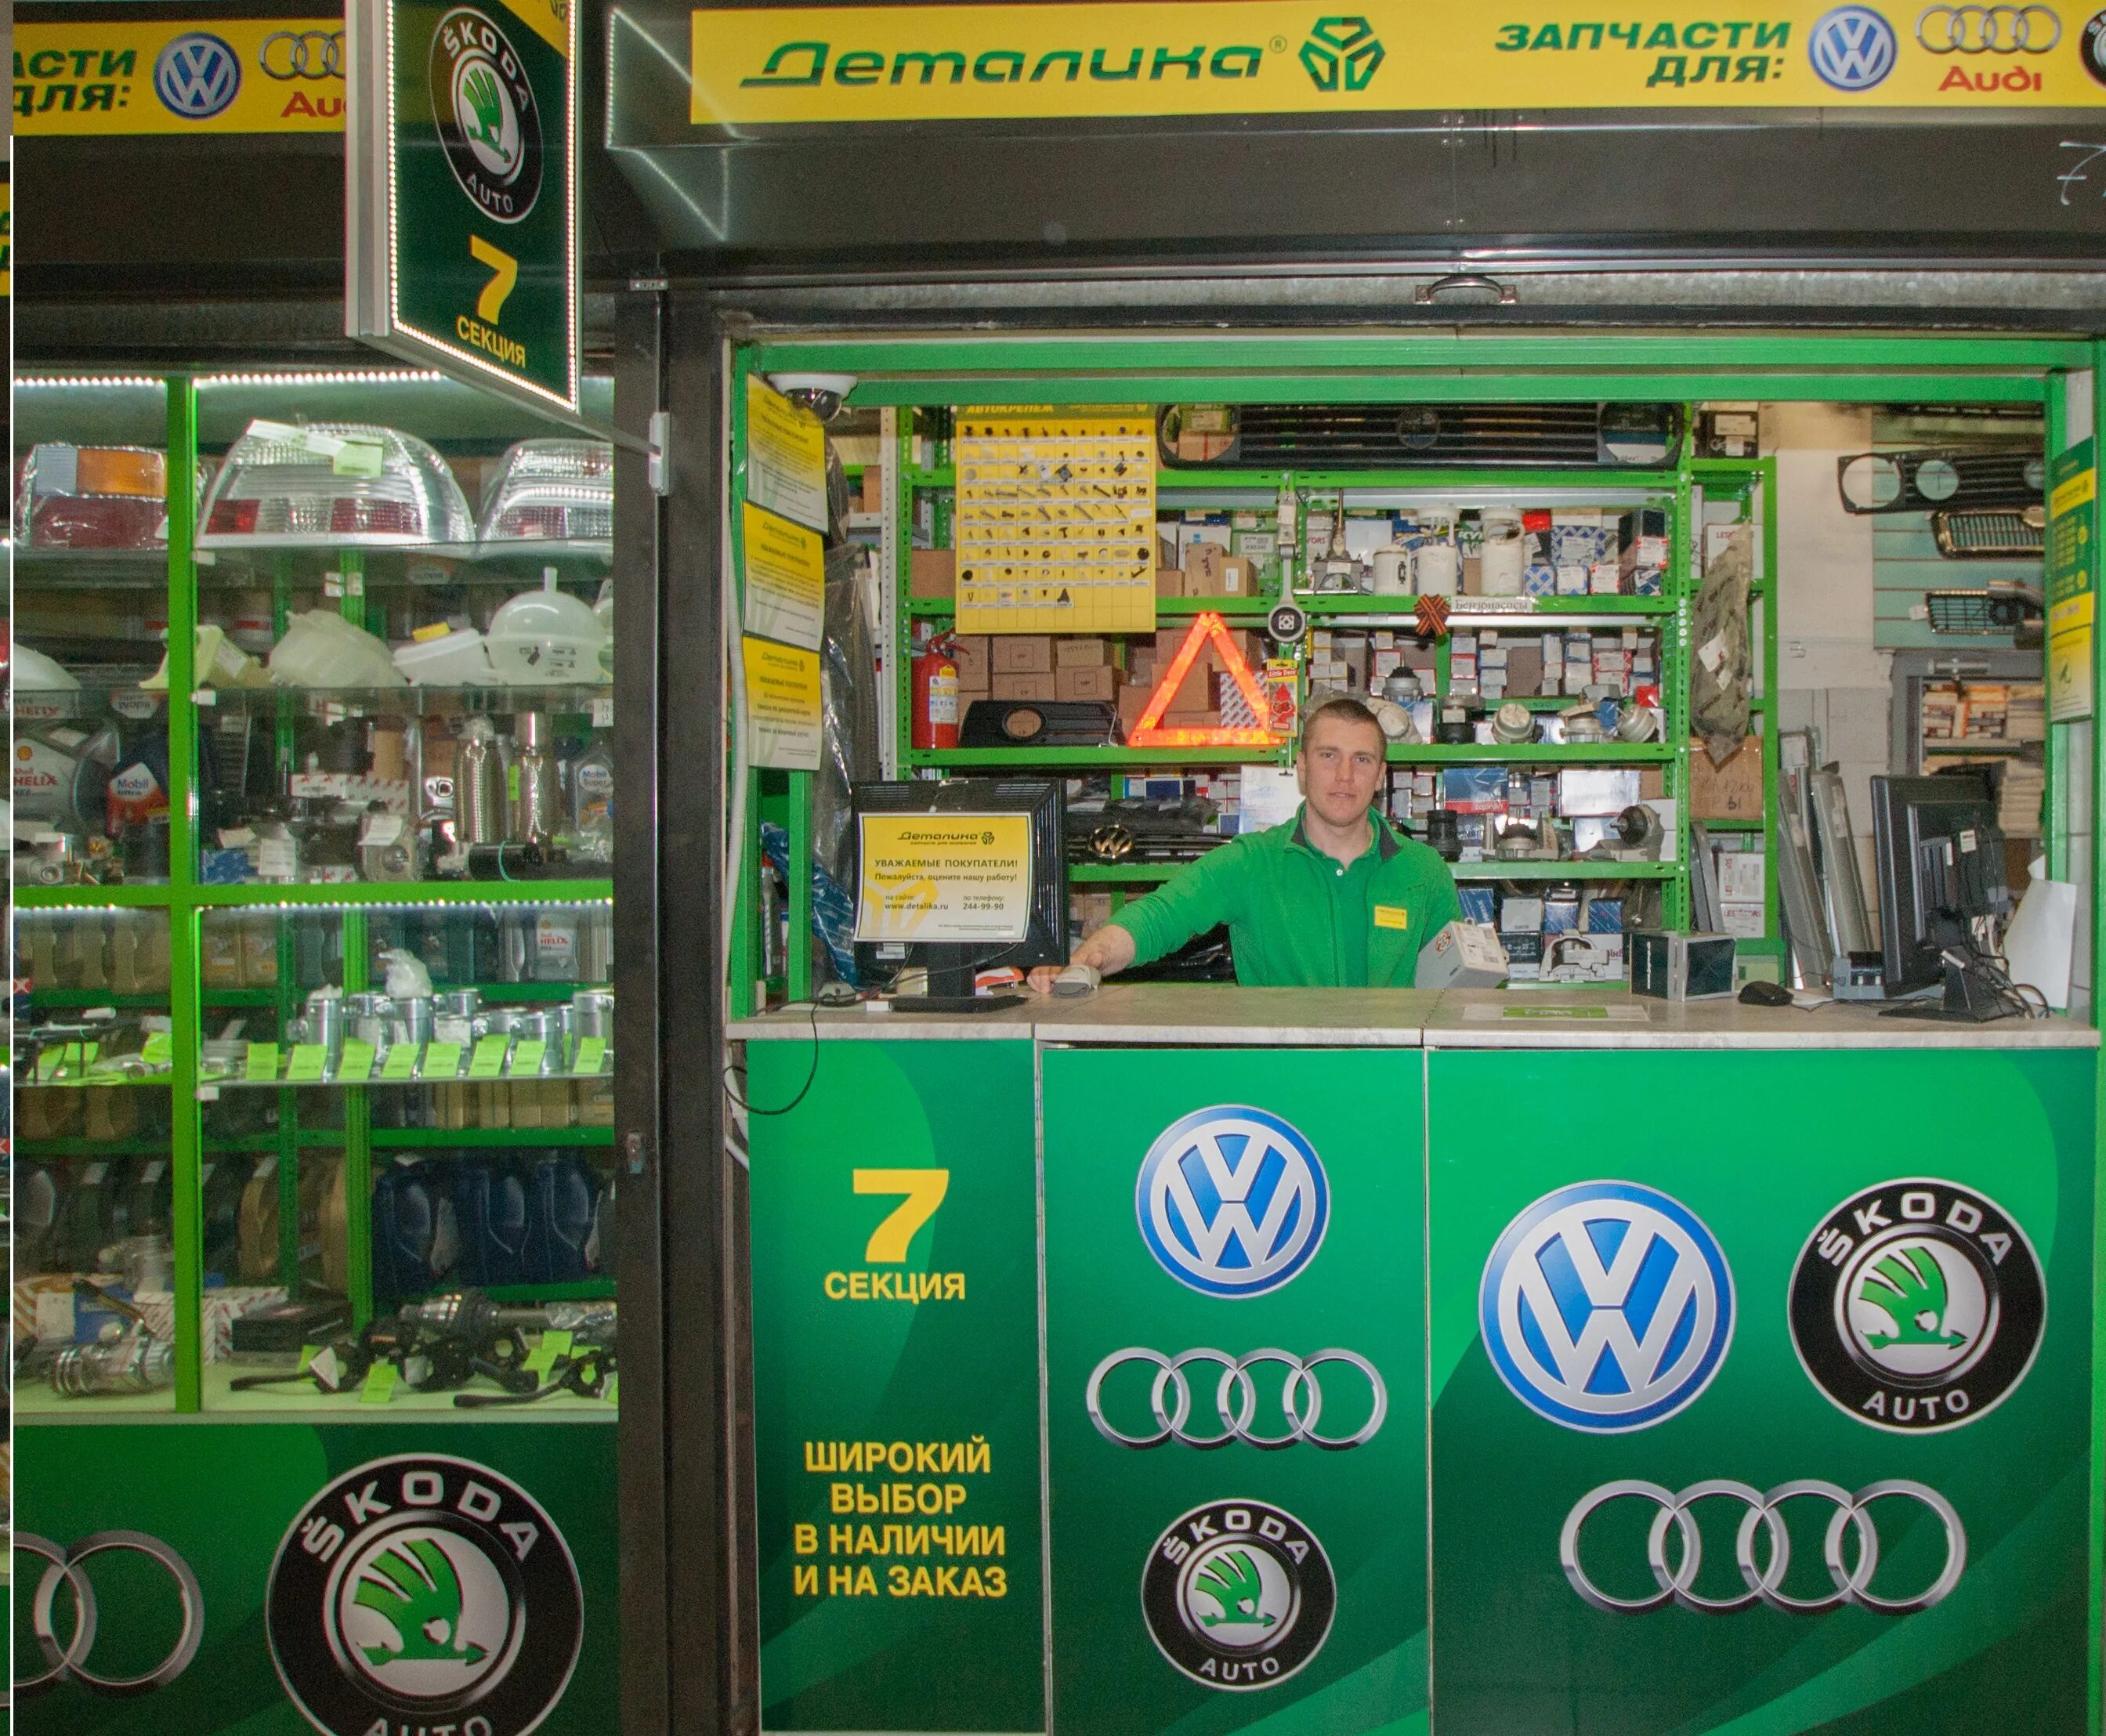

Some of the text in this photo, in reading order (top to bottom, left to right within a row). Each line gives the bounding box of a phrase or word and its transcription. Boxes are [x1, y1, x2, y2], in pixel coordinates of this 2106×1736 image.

[1495, 21, 1791, 51] ЗАПЧАСТИ
[443, 21, 530, 112] ŠKODA
[739, 41, 1262, 88] Деталика
[1646, 56, 1784, 88] ДЛЯ:
[1938, 65, 2043, 92] Audi
[280, 92, 346, 118] Au
[468, 173, 514, 213] AUTO
[470, 235, 518, 326] 7
[456, 314, 526, 369] СЕКЦИЯ
[1455, 599, 1528, 610] Бензонасосы
[117, 779, 149, 790] Mobil
[897, 831, 979, 840] Деталика
[874, 859, 1018, 868] УВАЖАЕМЫЕ ПОКУПАТЕЛИ!
[986, 873, 1017, 882] работу!
[853, 1169, 950, 1263] 7
[1817, 1191, 2017, 1266] ŠKODA
[825, 1271, 965, 1304] СЕКЦИЯ
[1862, 1387, 1970, 1421] AUTO
[805, 1435, 990, 1473] ШИРОКИЙ
[831, 1483, 967, 1514] ВЫБОР
[301, 1470, 540, 1563] ŠKODA
[794, 1524, 1005, 1556] В НАЛИЧИИ
[1163, 1510, 1309, 1565] ŠKODA
[794, 1565, 1007, 1598] И НА ЗАКАЗ
[1200, 1657, 1279, 1680] AUTO
